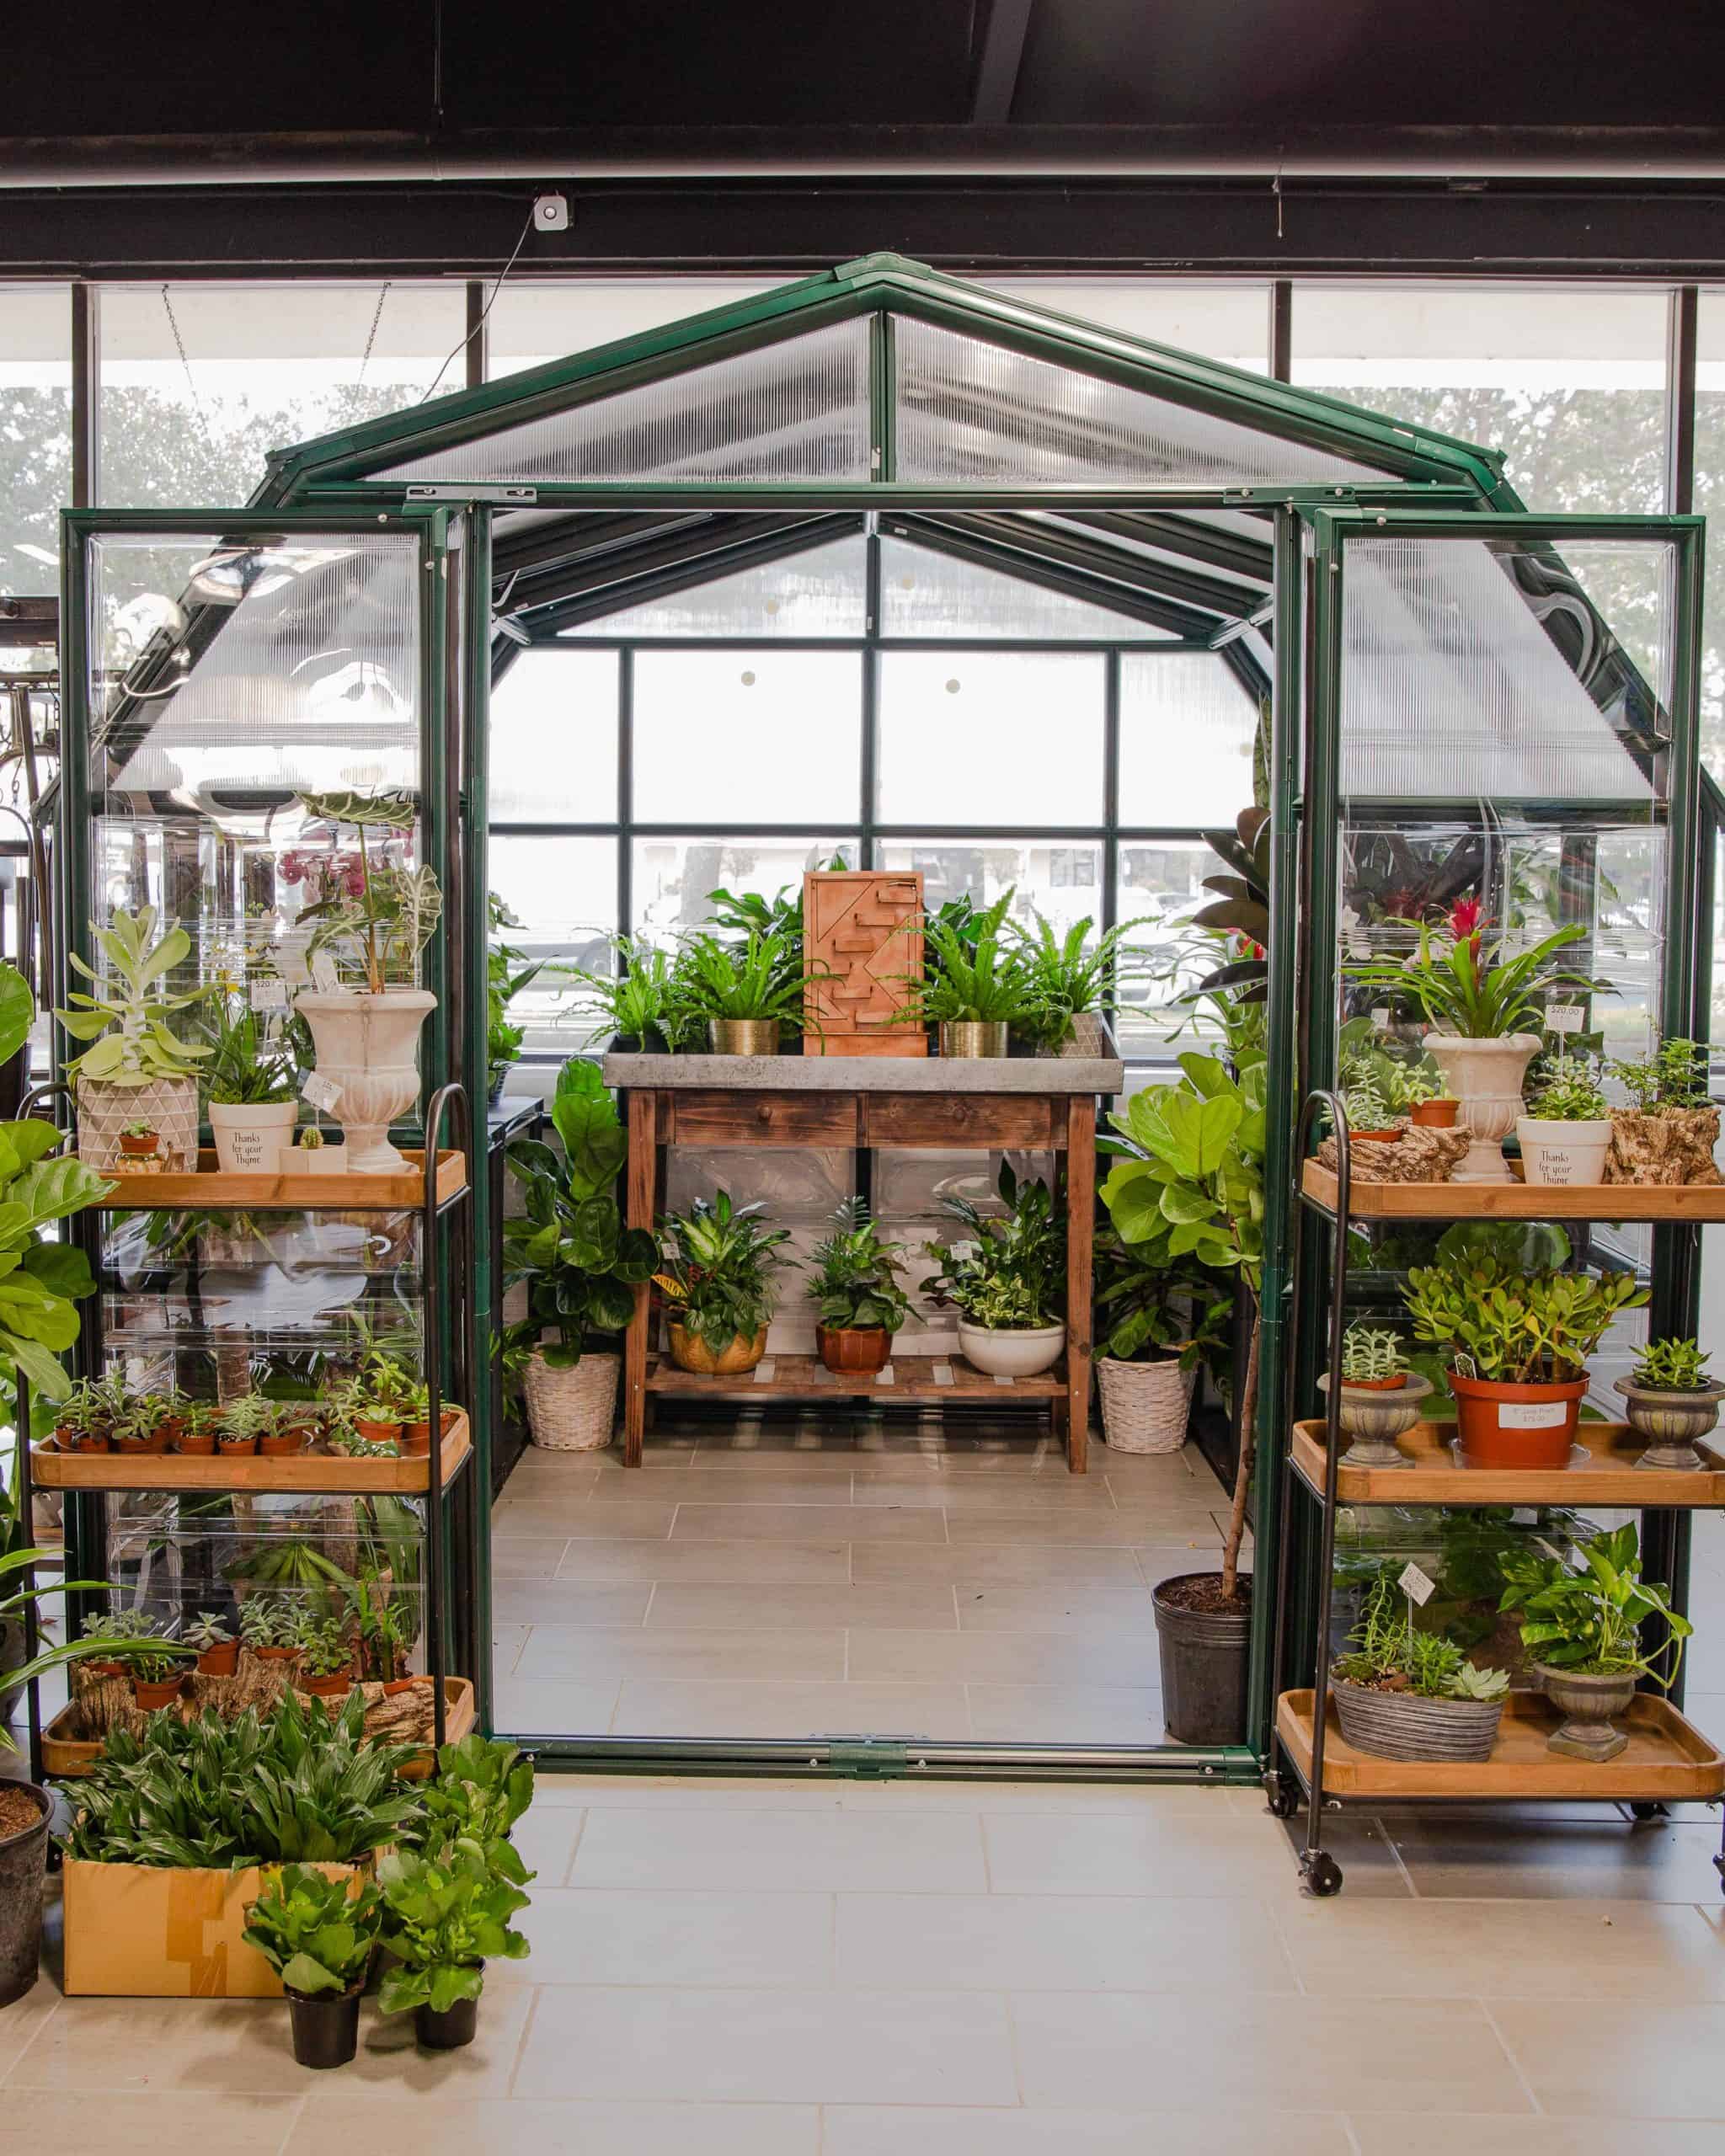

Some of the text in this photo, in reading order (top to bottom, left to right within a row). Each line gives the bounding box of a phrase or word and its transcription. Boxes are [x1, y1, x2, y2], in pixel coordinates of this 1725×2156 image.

[234, 1132, 260, 1144] Thanks
[232, 1145, 264, 1156] for your
[1541, 1150, 1569, 1162] Thanks
[236, 1153, 261, 1166] Thyme
[1538, 1161, 1573, 1176] for your
